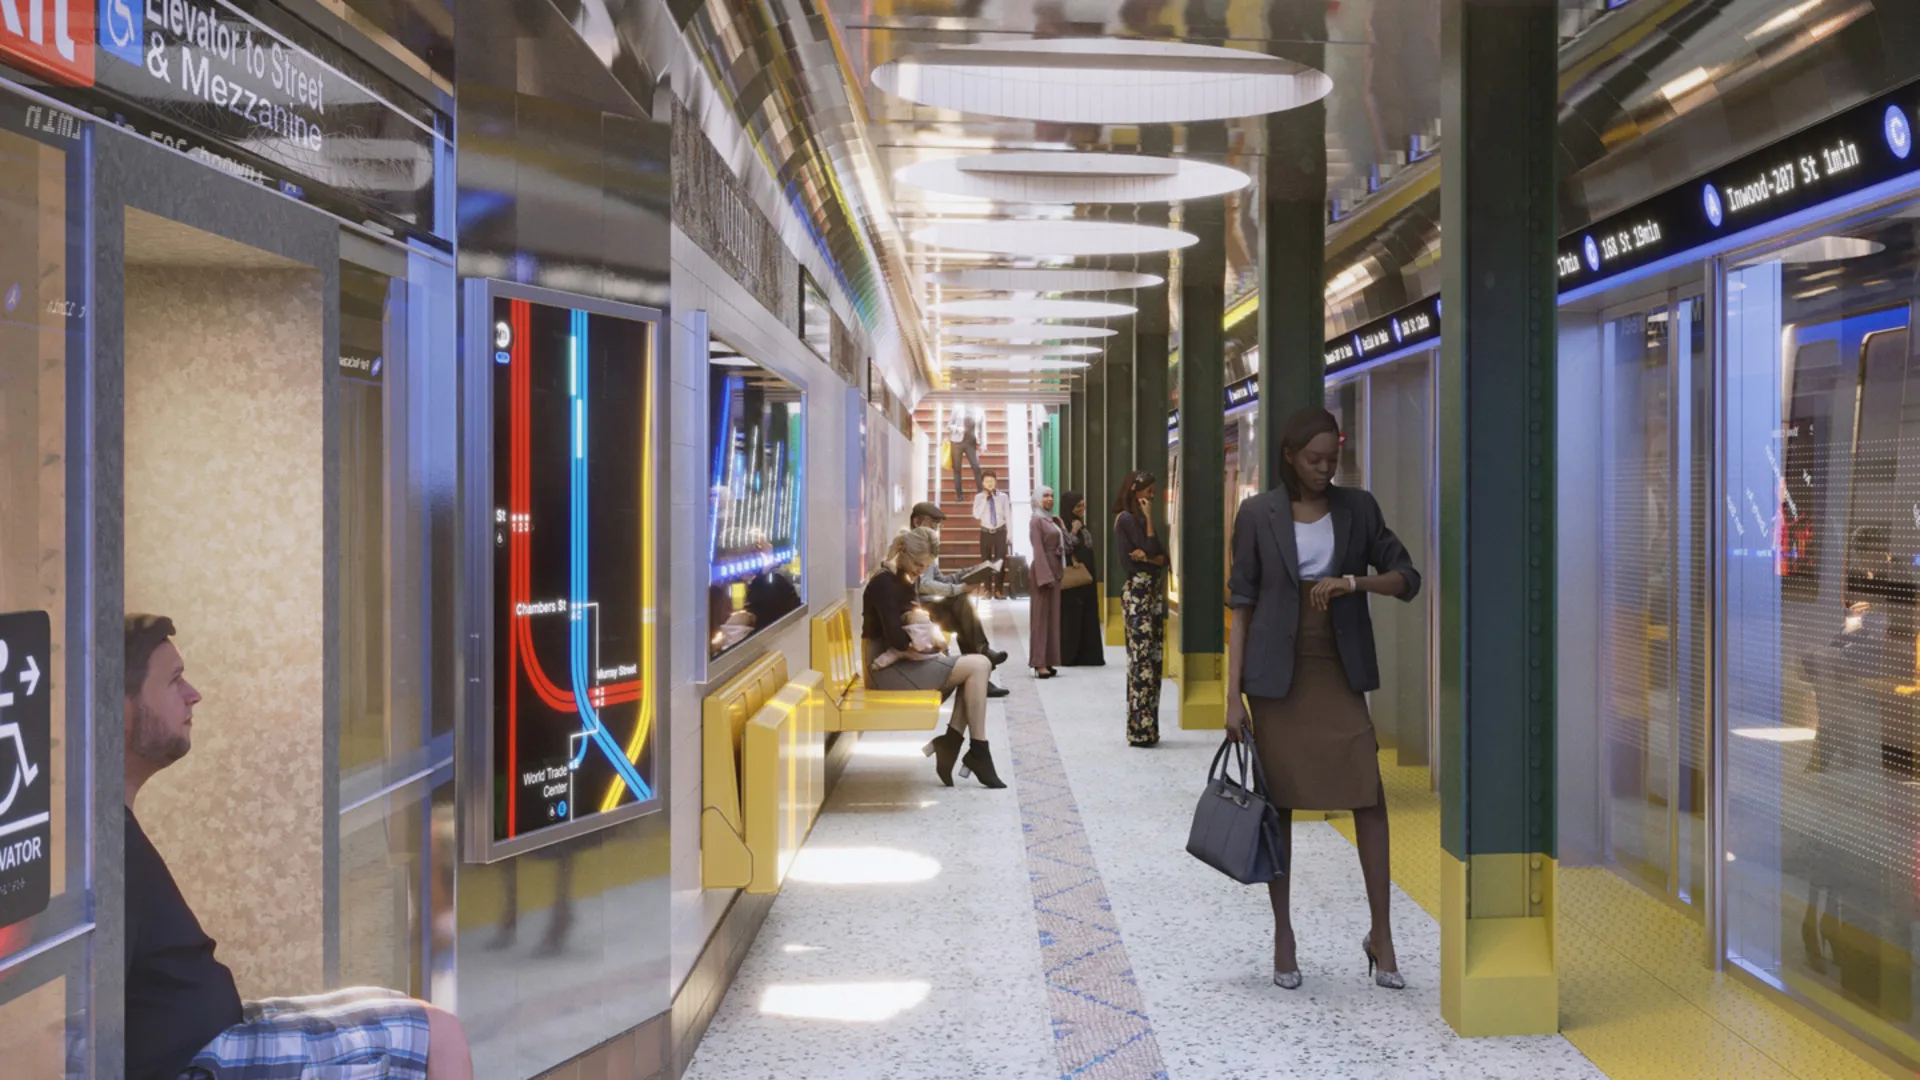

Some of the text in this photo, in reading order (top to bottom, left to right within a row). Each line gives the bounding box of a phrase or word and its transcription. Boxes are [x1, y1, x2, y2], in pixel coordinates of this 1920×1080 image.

[245, 29, 265, 79] to
[271, 42, 324, 115] Street
[147, 31, 322, 151] & Mezzanine
[1726, 163, 1795, 212] Inwood-207
[1800, 155, 1820, 184] St
[1823, 140, 1860, 175] 1min
[1601, 236, 1618, 259] 168
[1619, 231, 1632, 253] St
[496, 509, 506, 522] St
[516, 599, 567, 615] Chambers St
[523, 766, 567, 786] World Trade
[543, 783, 567, 798] Center
